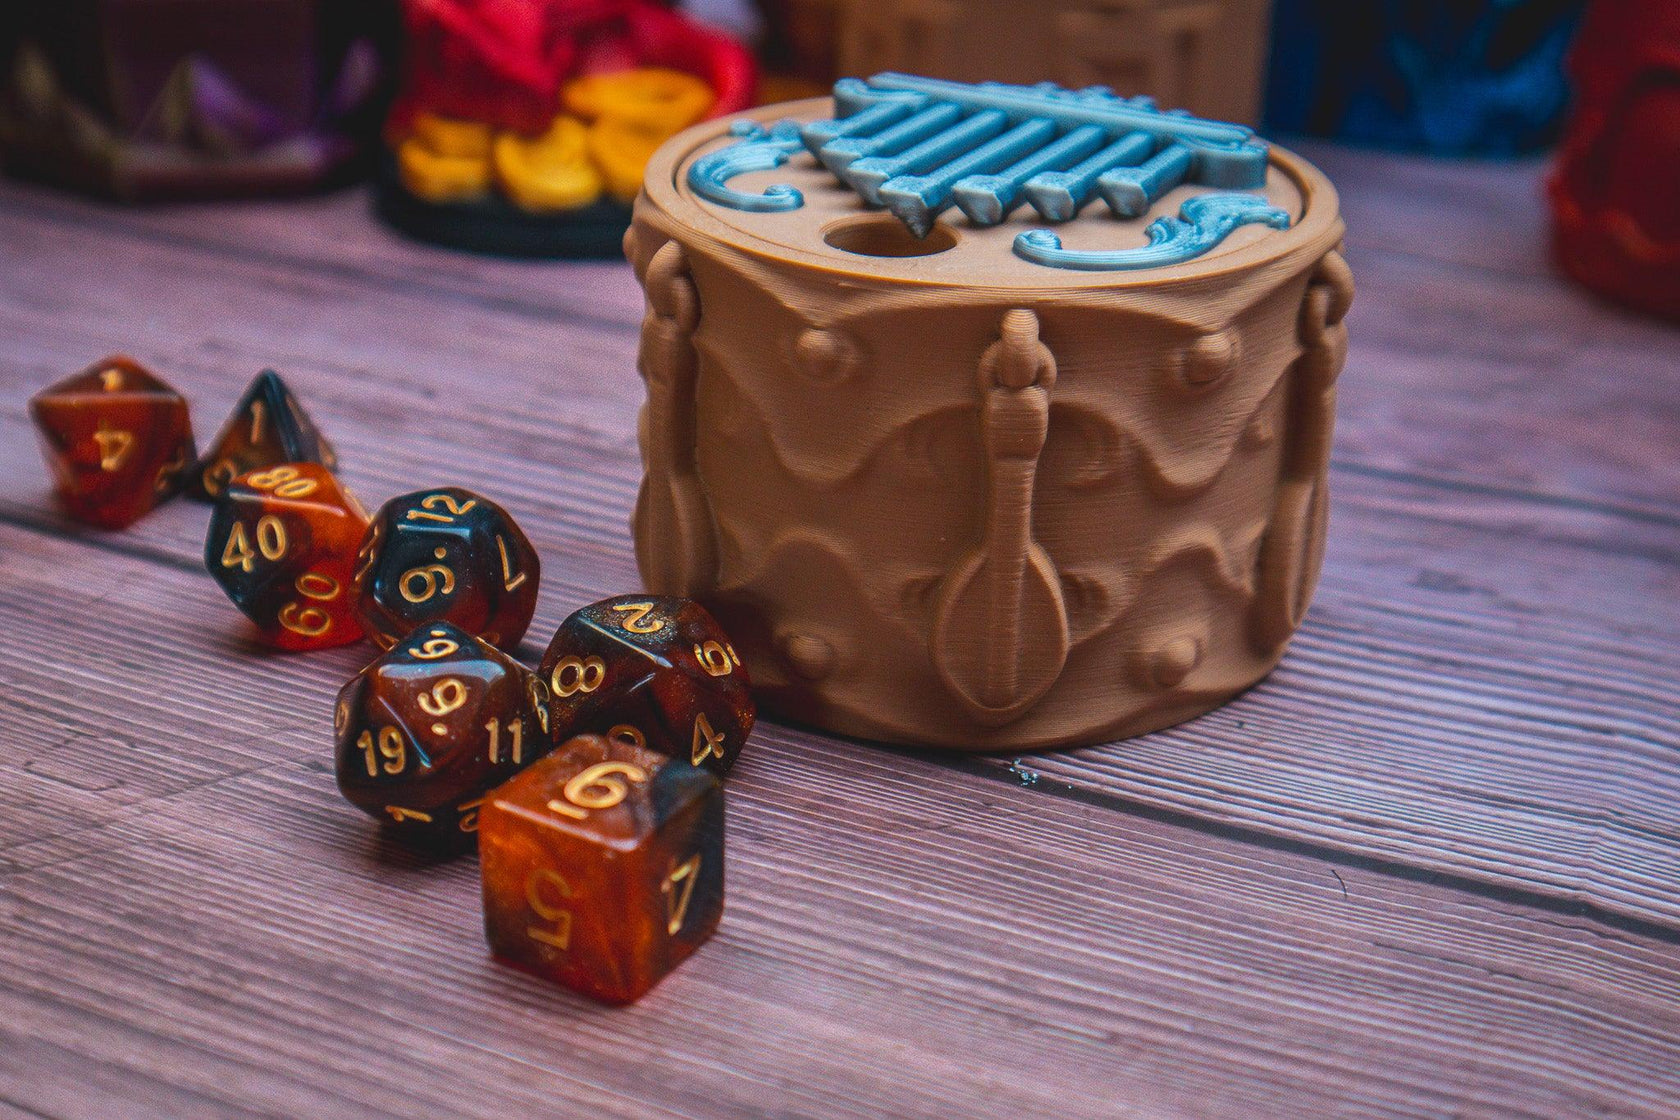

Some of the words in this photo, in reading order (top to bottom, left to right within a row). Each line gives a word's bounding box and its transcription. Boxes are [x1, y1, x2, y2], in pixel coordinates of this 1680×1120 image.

[251, 400, 265, 444] 1
[247, 466, 317, 498] 80
[406, 494, 477, 523] 12
[221, 514, 287, 573] 40
[496, 534, 526, 592] 7
[612, 602, 665, 633] 2
[552, 655, 606, 697] 8
[357, 725, 407, 777] 19
[485, 716, 522, 765] 11
[692, 712, 726, 767] 4
[526, 869, 573, 949] 5
